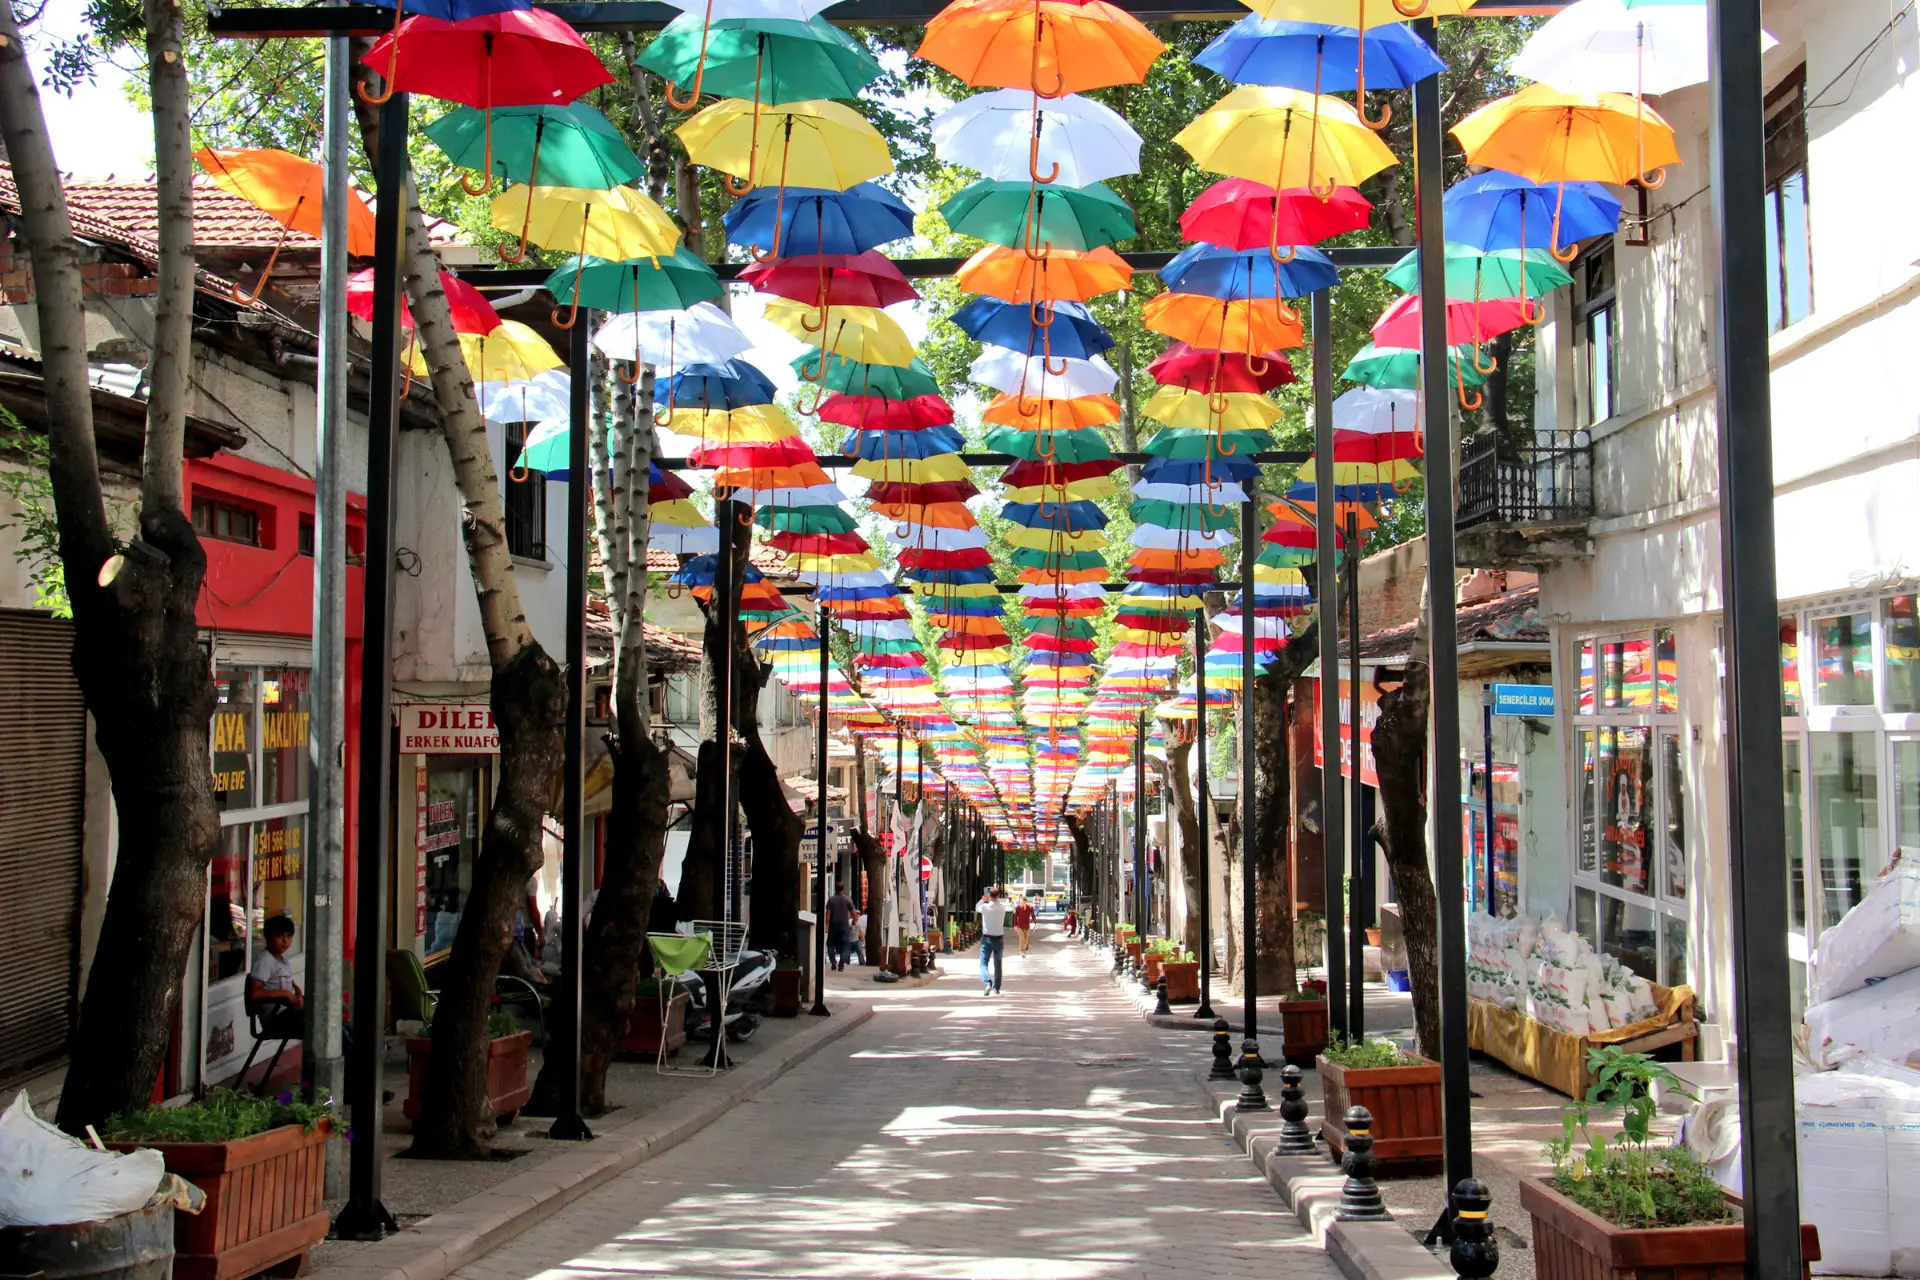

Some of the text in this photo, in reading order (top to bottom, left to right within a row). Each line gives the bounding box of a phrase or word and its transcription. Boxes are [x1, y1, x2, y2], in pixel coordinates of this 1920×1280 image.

[1499, 694, 1537, 706] SEMERCİLER
[263, 703, 310, 748] NAKLİYAT
[406, 735, 450, 748] ERKEK
[230, 770, 246, 790] EVE
